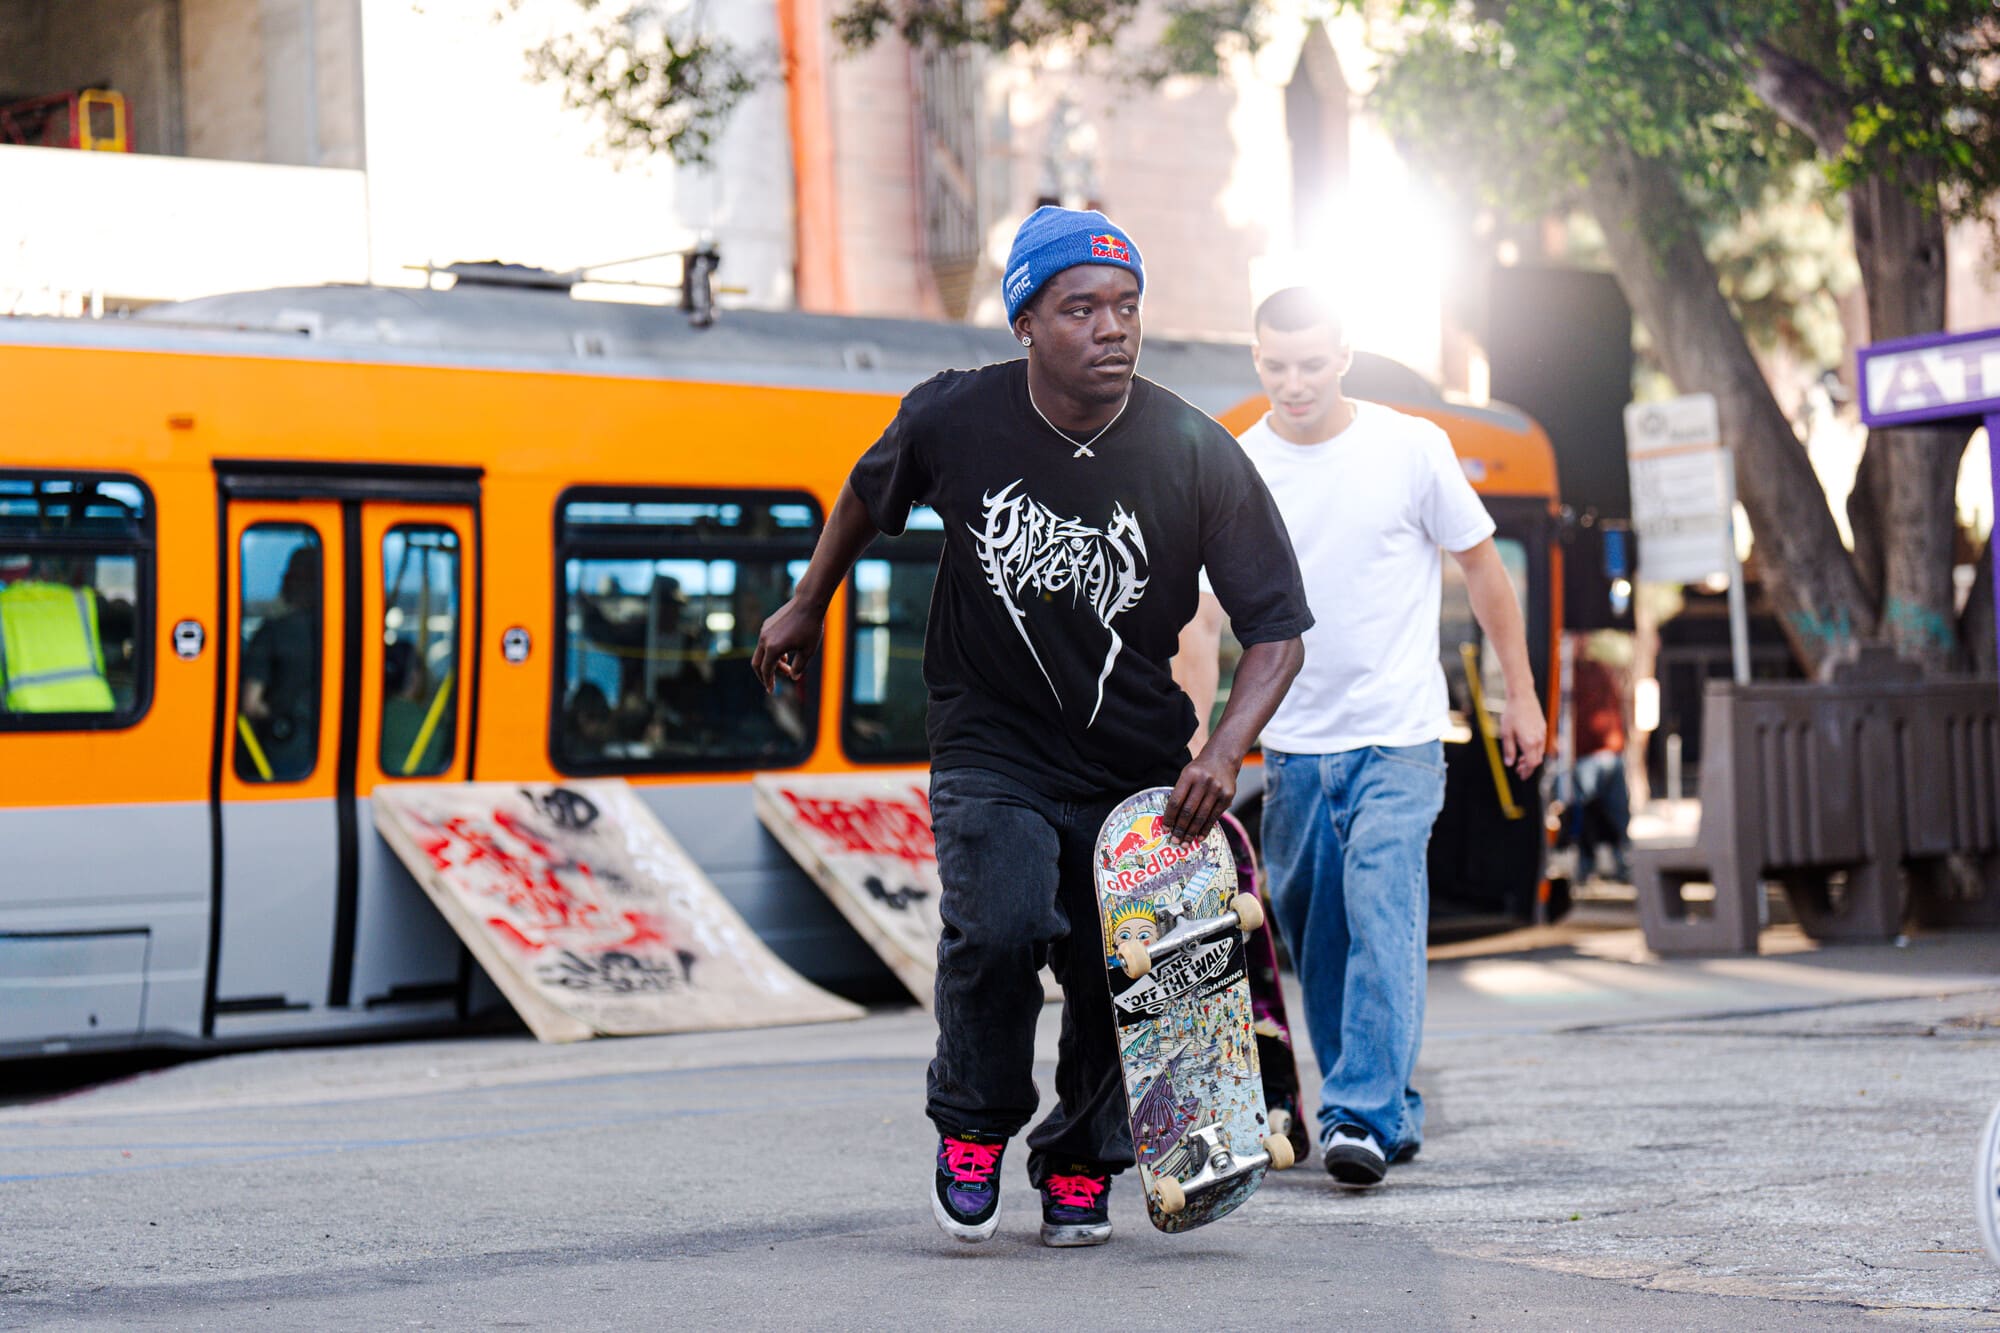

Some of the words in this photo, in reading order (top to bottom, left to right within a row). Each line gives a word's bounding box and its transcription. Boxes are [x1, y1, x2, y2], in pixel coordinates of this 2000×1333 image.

[1092, 247, 1112, 258] Red
[1113, 248, 1129, 263] Bull
[1009, 274, 1031, 304] KMC
[1117, 853, 1160, 892] Red
[1148, 955, 1192, 983] VANS
[1158, 968, 1193, 996] THE
